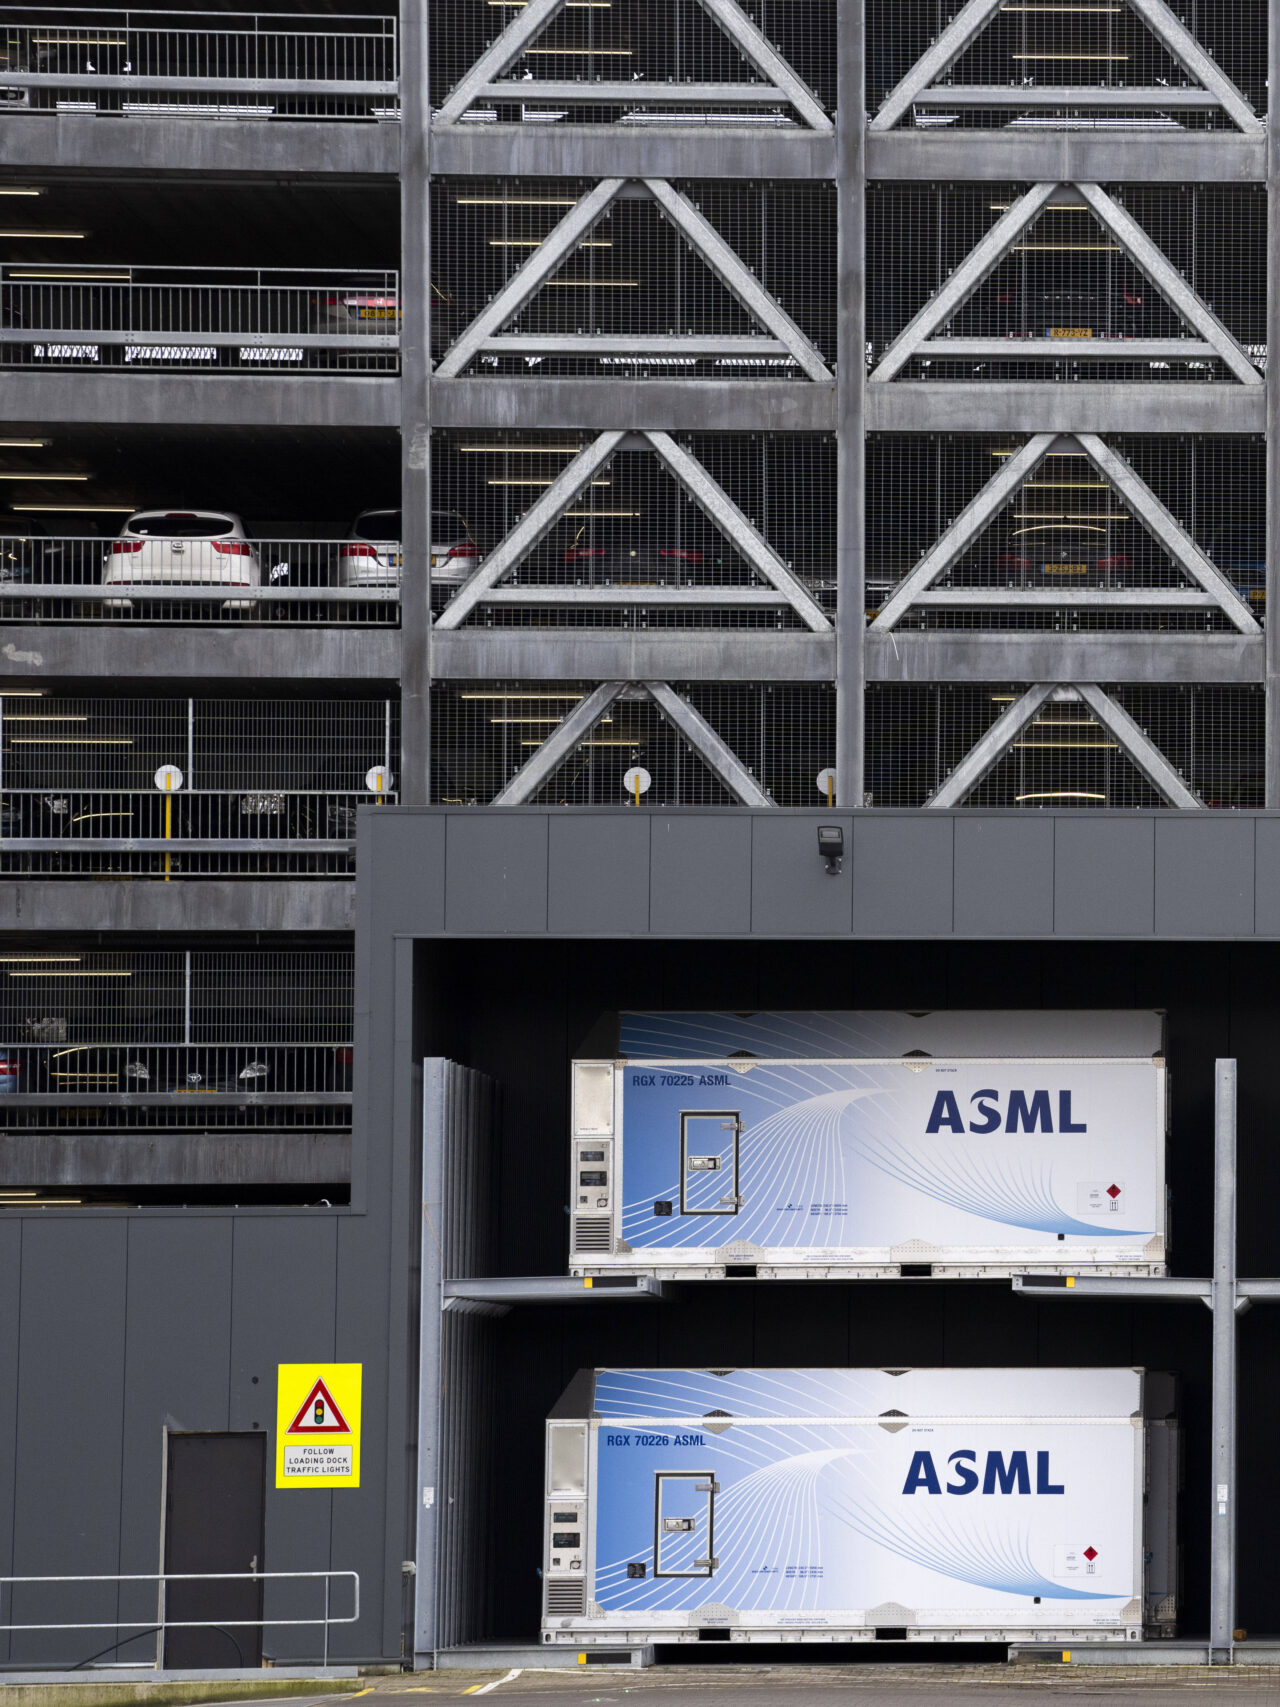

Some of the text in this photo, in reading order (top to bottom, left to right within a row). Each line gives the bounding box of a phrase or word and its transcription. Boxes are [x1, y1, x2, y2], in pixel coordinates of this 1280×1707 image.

[632, 1074, 731, 1087] RGX 70225 ASML
[925, 1088, 1087, 1134] ASML
[607, 1435, 706, 1446] RGX 70226 ASML
[902, 1449, 1065, 1495] ASML
